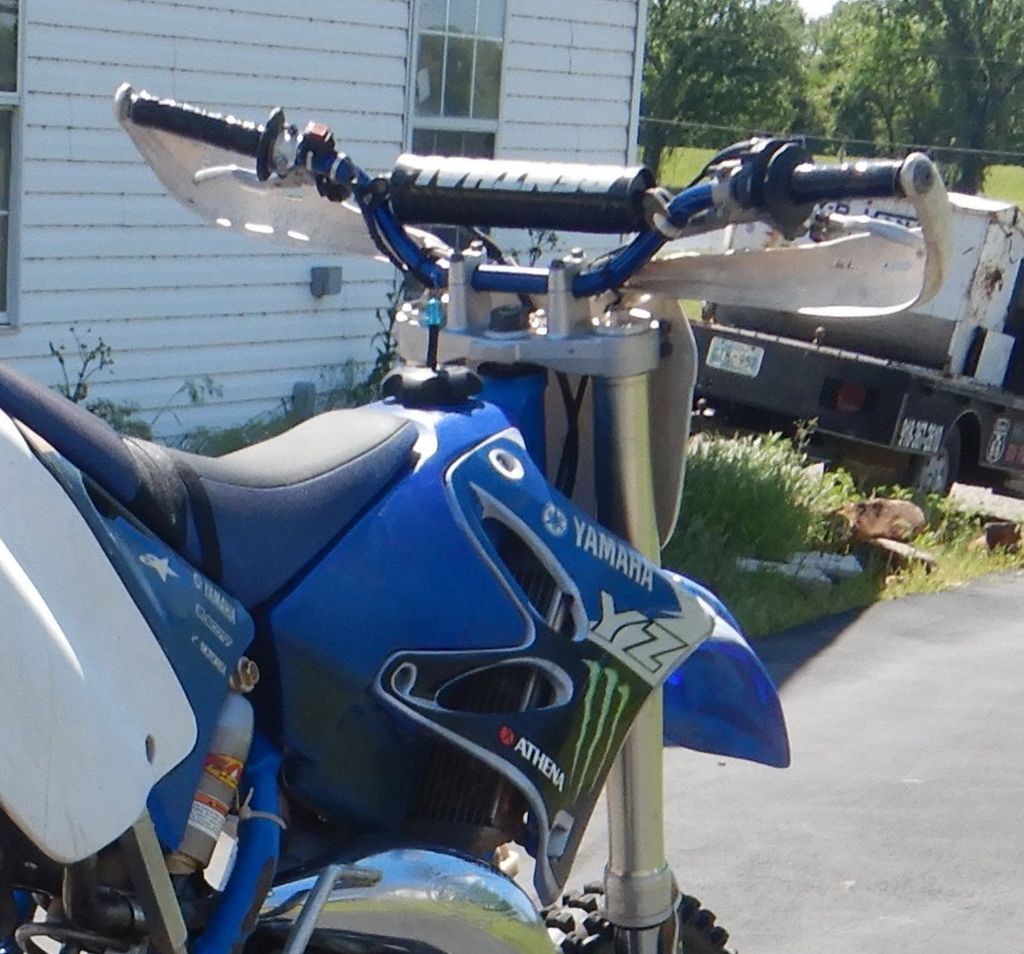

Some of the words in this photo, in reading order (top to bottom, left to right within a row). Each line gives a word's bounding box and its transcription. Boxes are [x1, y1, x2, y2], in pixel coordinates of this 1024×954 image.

[573, 516, 655, 592] YAMAHA
[590, 589, 689, 675] YZ
[514, 737, 565, 793] ATHENA
